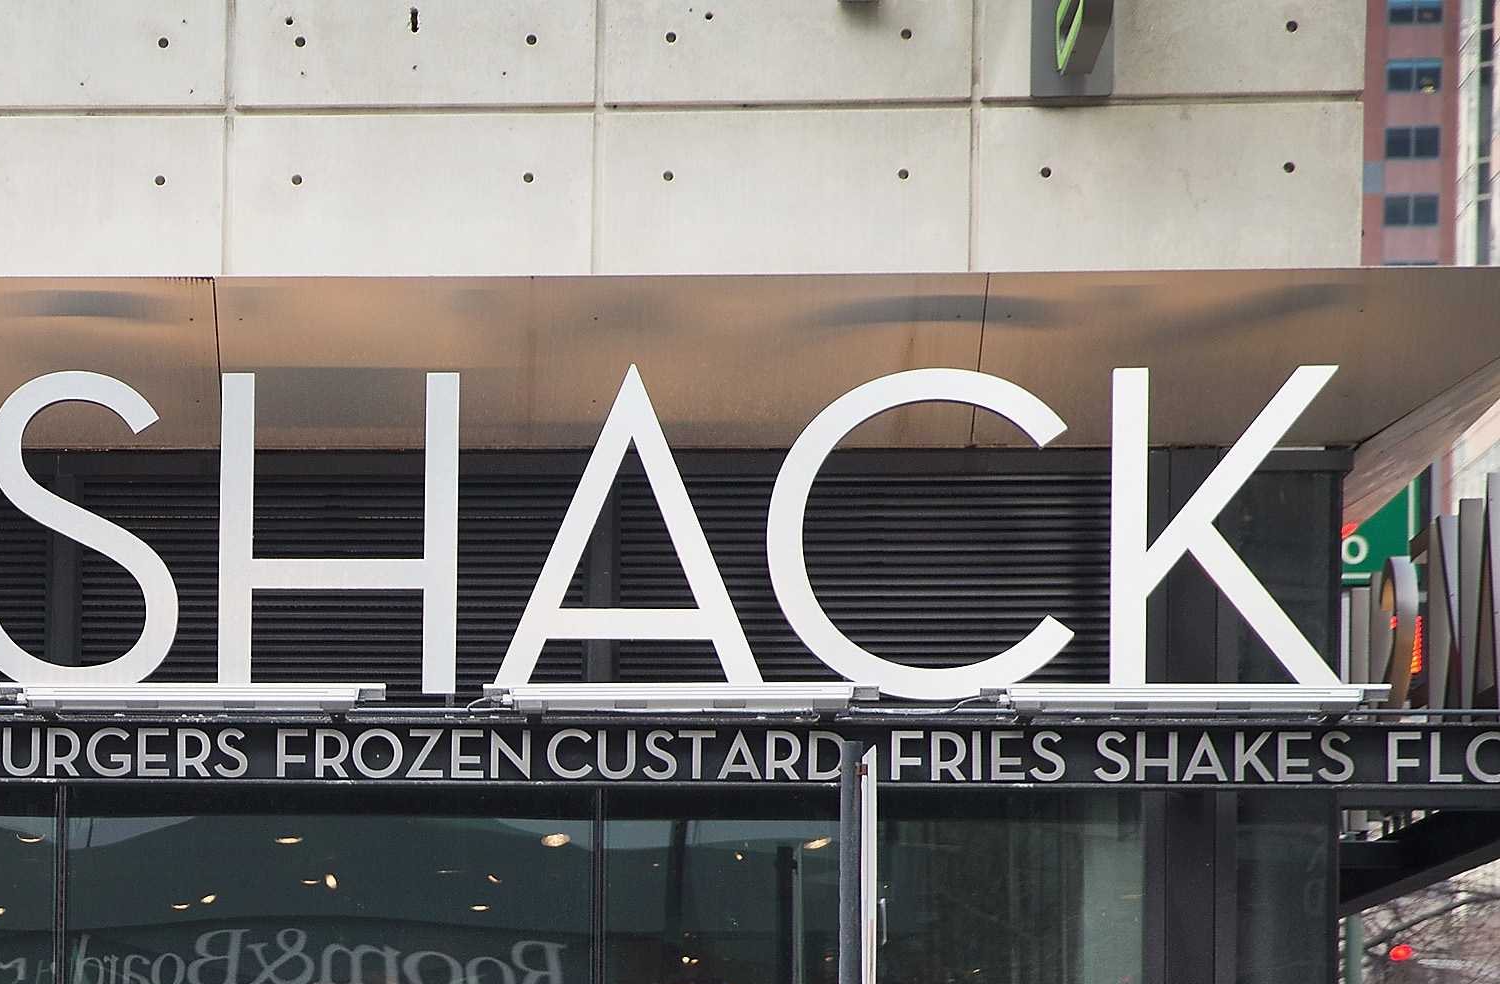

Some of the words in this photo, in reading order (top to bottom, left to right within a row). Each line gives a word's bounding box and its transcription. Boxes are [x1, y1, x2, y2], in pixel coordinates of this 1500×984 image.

[276, 728, 532, 780] FROZEN
[546, 729, 843, 781] CUSTARD
[890, 730, 1067, 782] FRIES
[1093, 731, 1356, 783] SHAKES
